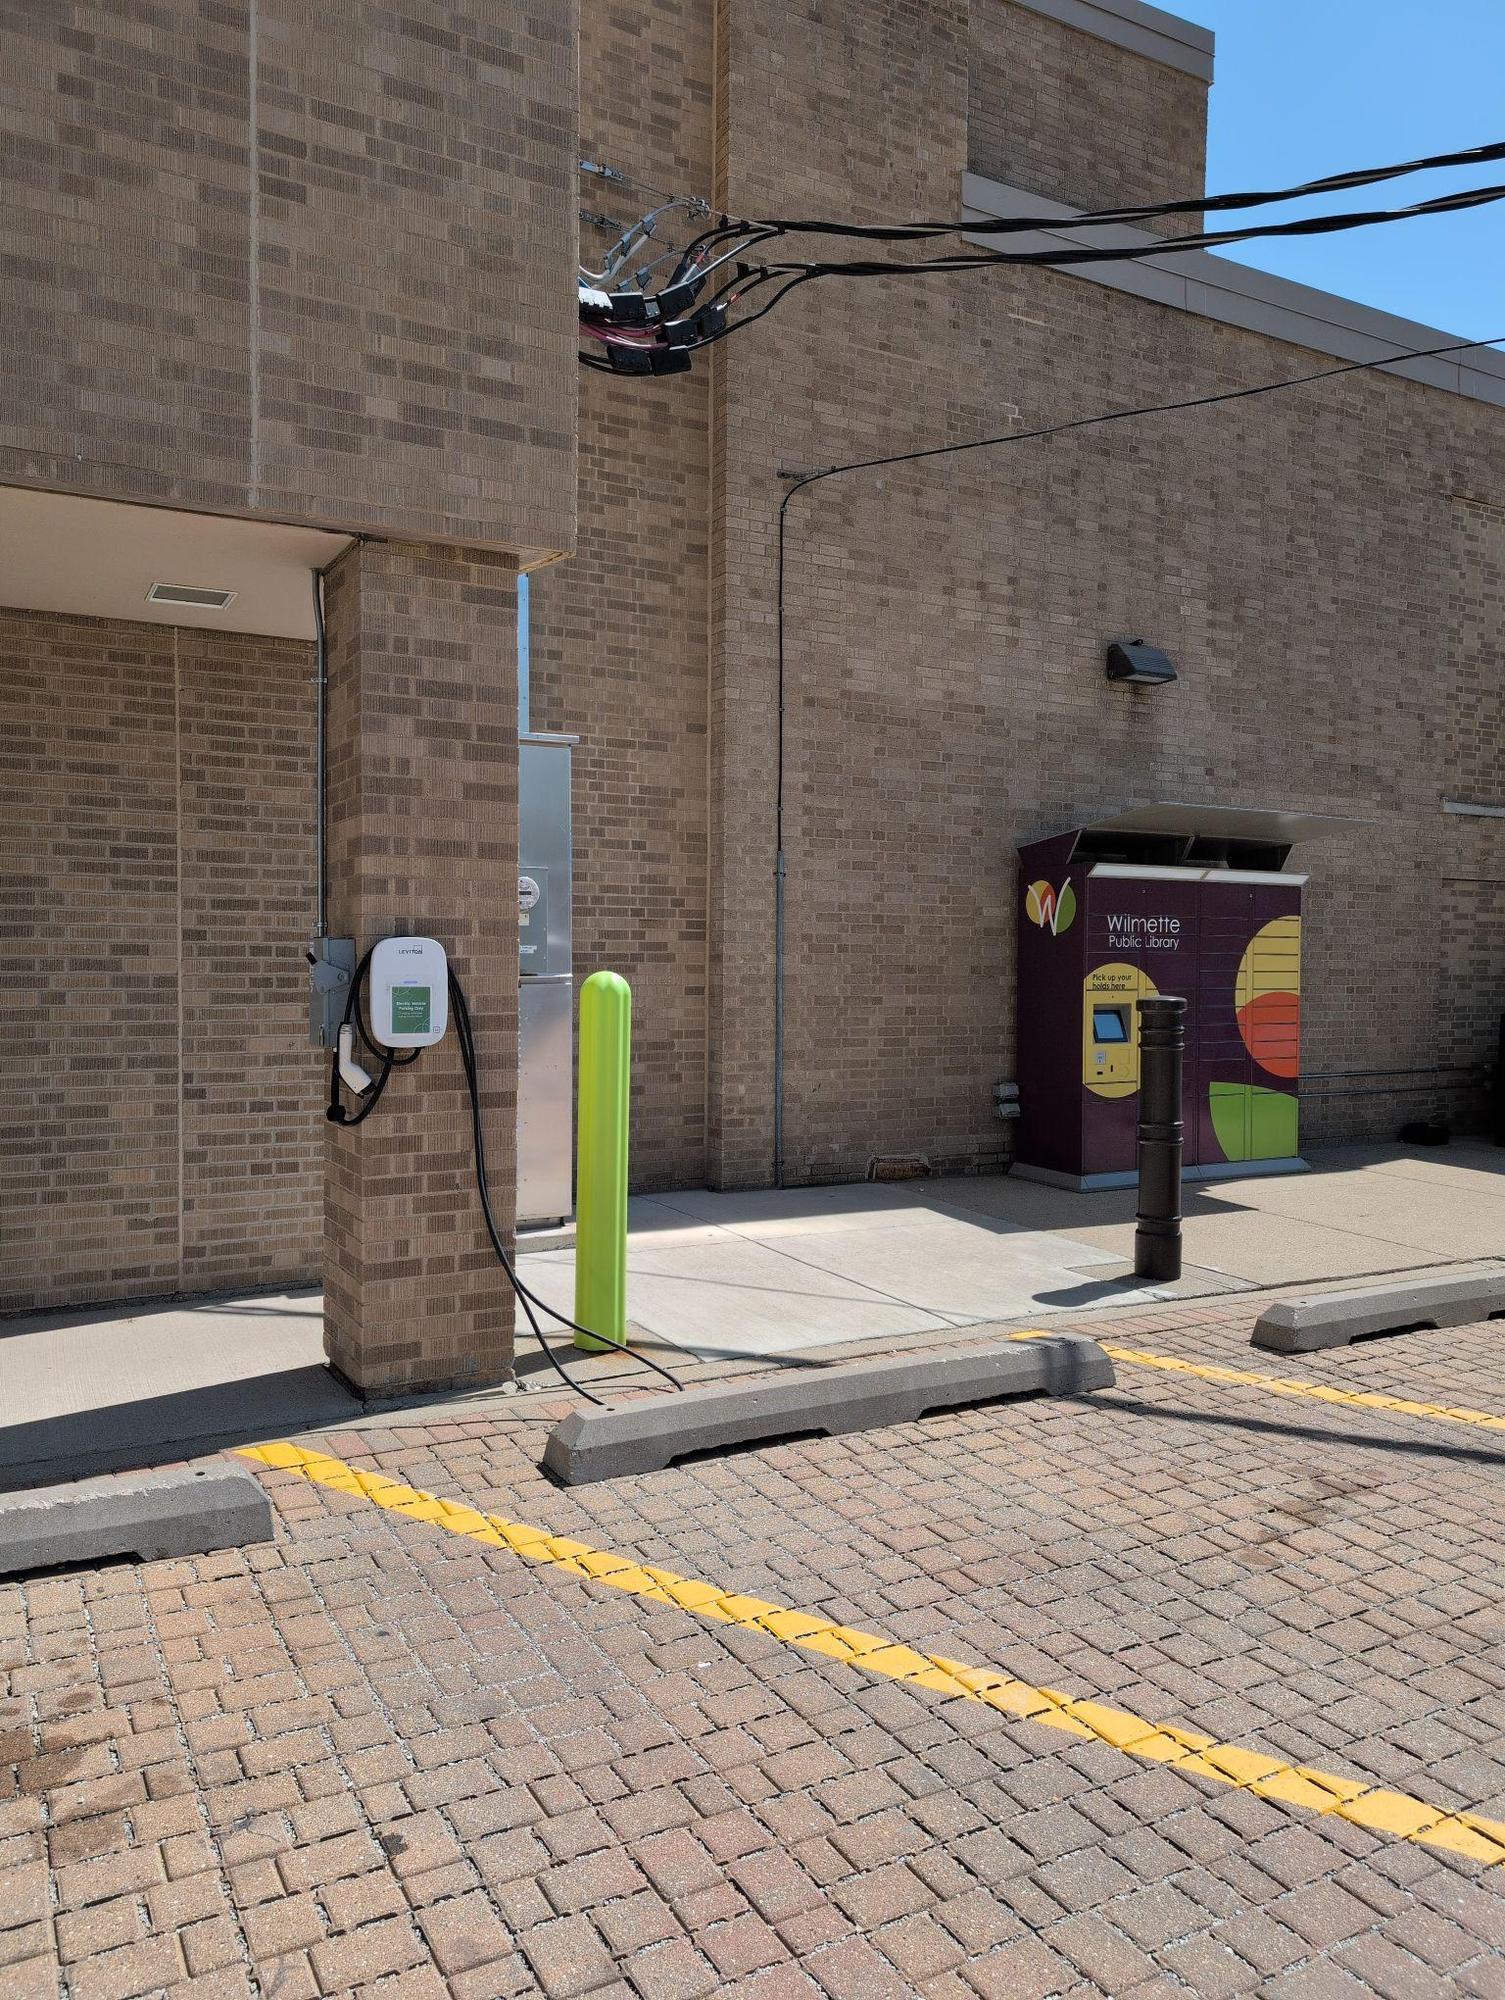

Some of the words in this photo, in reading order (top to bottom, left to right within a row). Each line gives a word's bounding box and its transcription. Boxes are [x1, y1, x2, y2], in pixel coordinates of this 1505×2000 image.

[1028, 876, 1071, 936] W
[1107, 914, 1180, 933] Wilmette
[1109, 935, 1142, 948] Public
[1145, 935, 1180, 951] Library
[1092, 982, 1110, 991] holds
[1111, 983, 1126, 991] here
[1108, 975, 1116, 983] up
[1118, 975, 1132, 983] your
